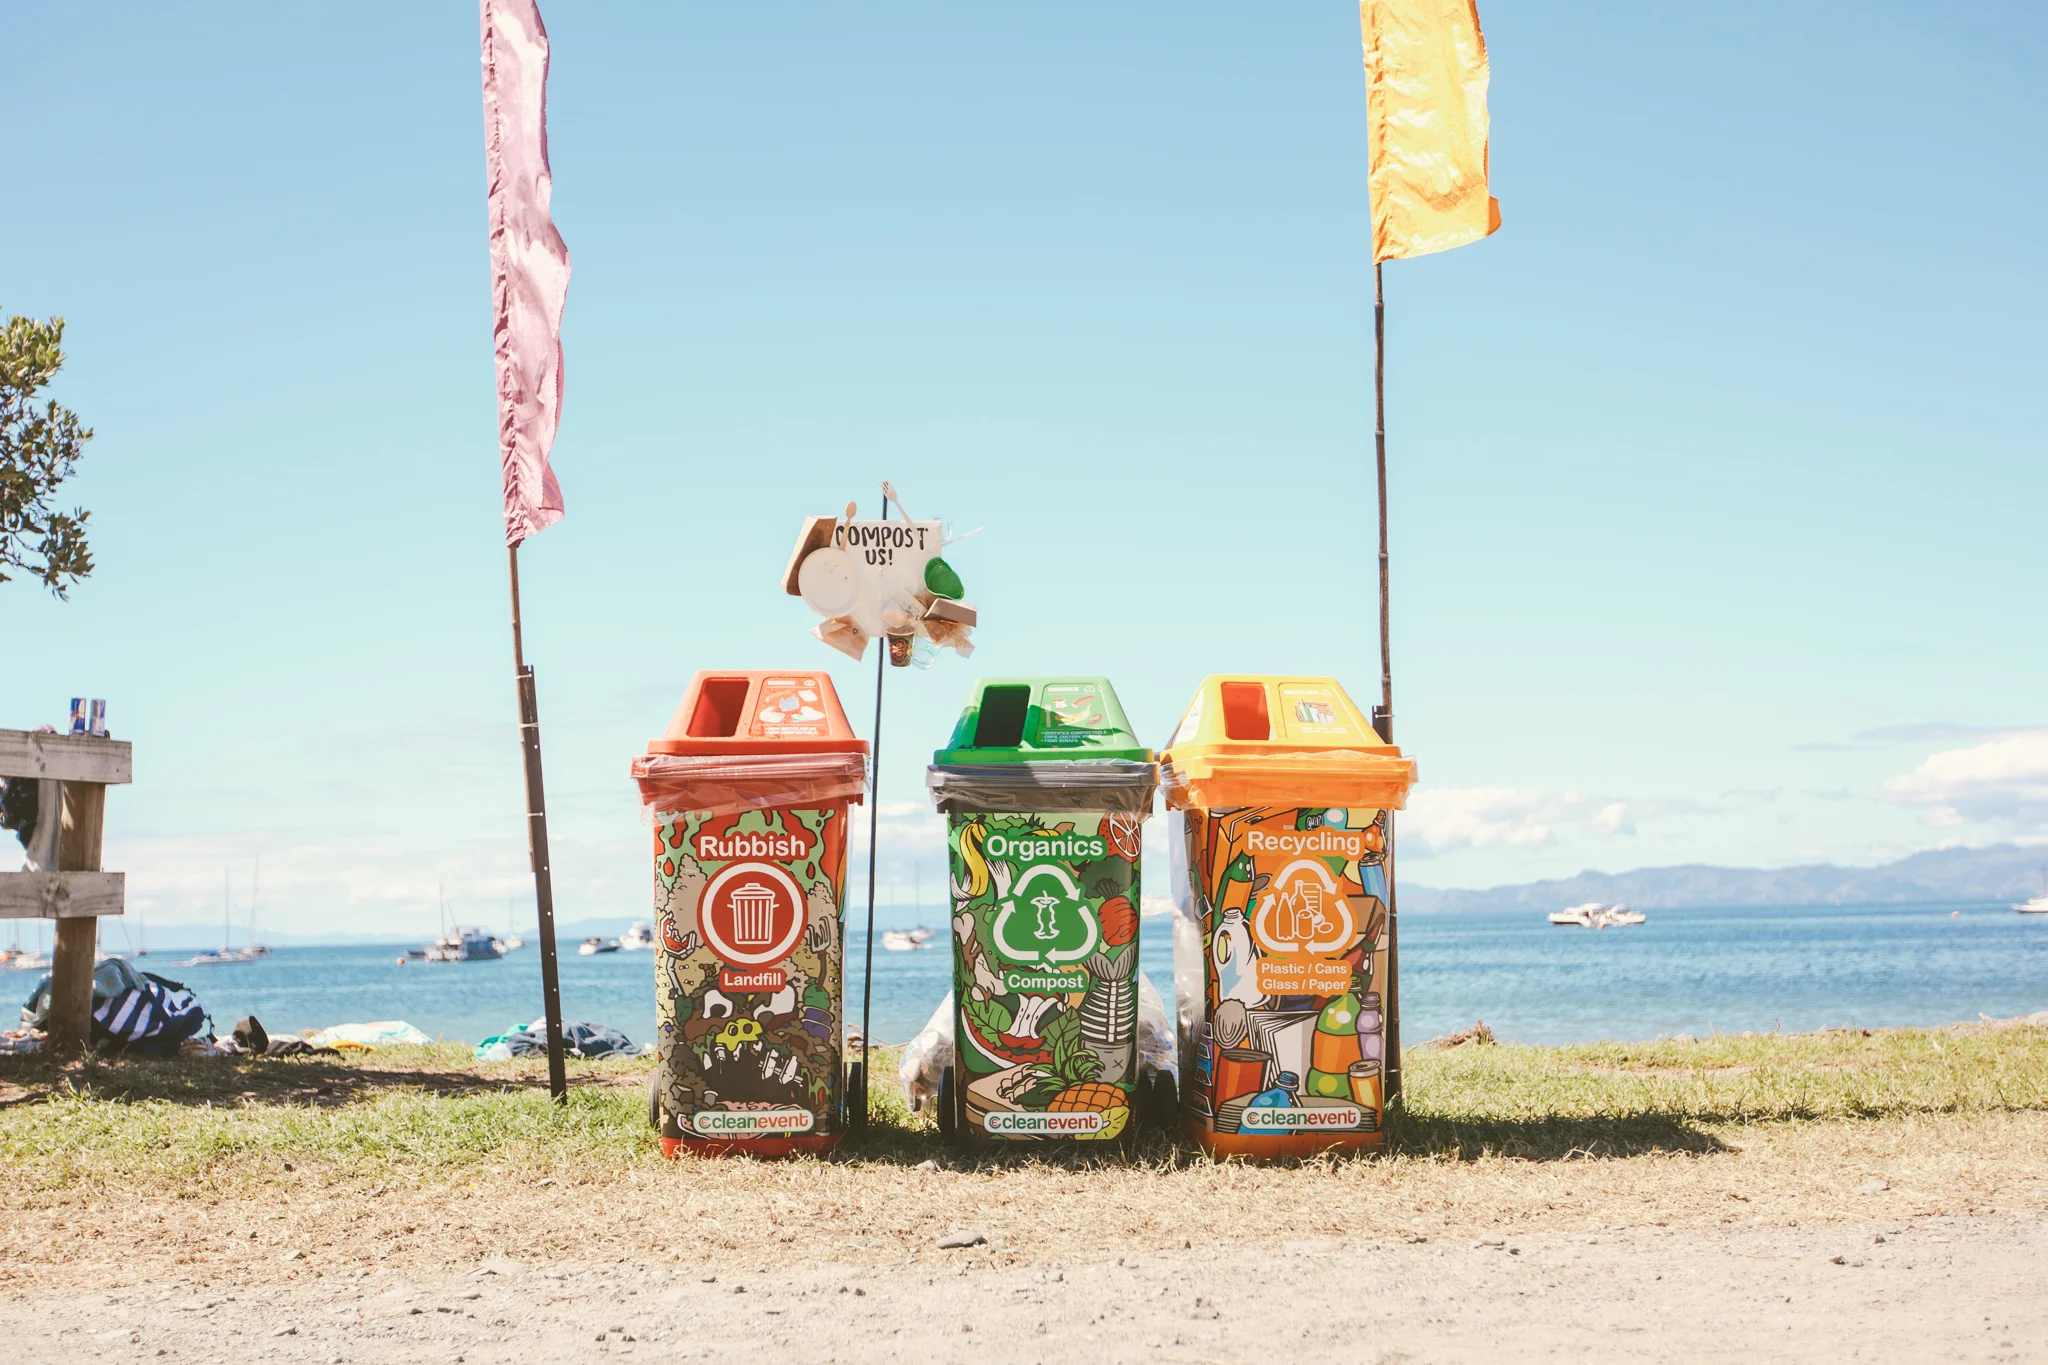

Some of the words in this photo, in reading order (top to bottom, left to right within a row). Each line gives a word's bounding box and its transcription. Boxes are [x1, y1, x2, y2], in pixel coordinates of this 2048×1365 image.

[835, 525, 929, 551] COMPOST
[864, 548, 893, 566] US!
[700, 835, 806, 857] Rubbish
[987, 835, 1103, 862] Organics
[1247, 830, 1361, 855] Recycling
[1261, 962, 1305, 974] Plastic
[1315, 963, 1347, 974] Cans
[724, 972, 782, 986] Landfill
[1008, 974, 1084, 991] Compost
[1262, 978, 1299, 990] Glass
[1309, 979, 1346, 992] Paper
[712, 1113, 808, 1129] cleanevent
[1002, 1114, 1098, 1129] cleanevent
[1261, 1110, 1357, 1125] cleanevent
